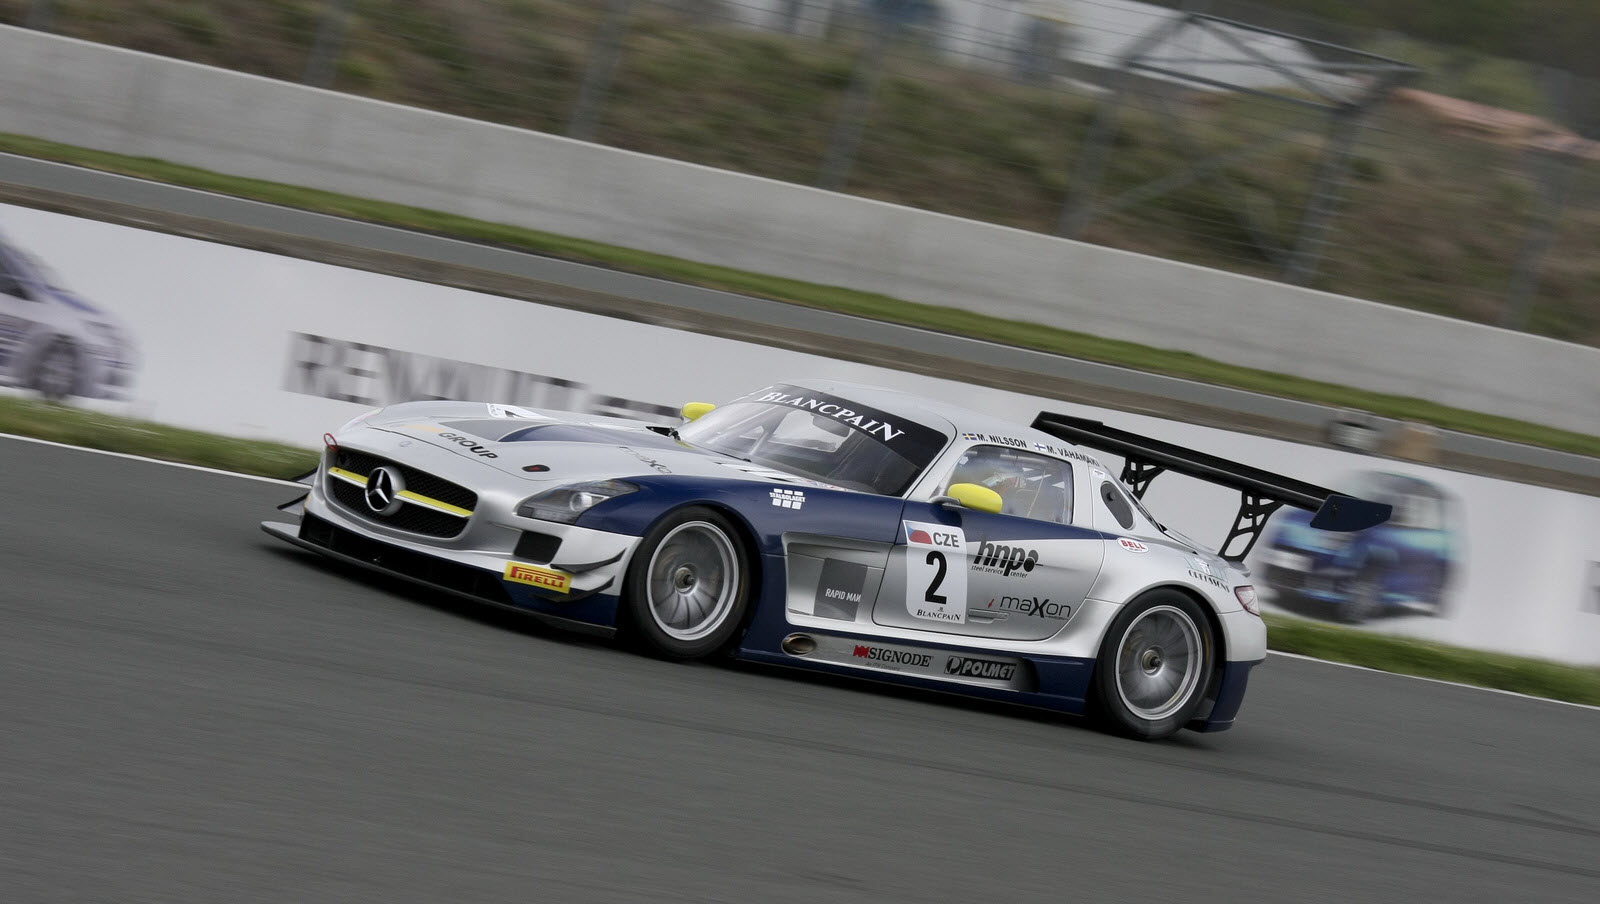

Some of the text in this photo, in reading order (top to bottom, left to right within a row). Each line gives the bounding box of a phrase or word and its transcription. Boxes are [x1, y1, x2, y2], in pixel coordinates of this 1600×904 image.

[755, 392, 905, 442] BLANCPAIN
[438, 432, 499, 459] GROUP
[976, 433, 1028, 449] M. NILSSON
[1046, 445, 1058, 454] M.
[933, 532, 960, 548] CZE
[1120, 539, 1146, 550] BELL
[510, 566, 566, 589] PIRELLI
[925, 550, 947, 605] 2
[985, 567, 1004, 575] service
[825, 588, 846, 600] RAPID
[916, 609, 961, 621] BLANCPAIN
[868, 647, 932, 668] SIGNODE
[962, 660, 1015, 679] POLMET
